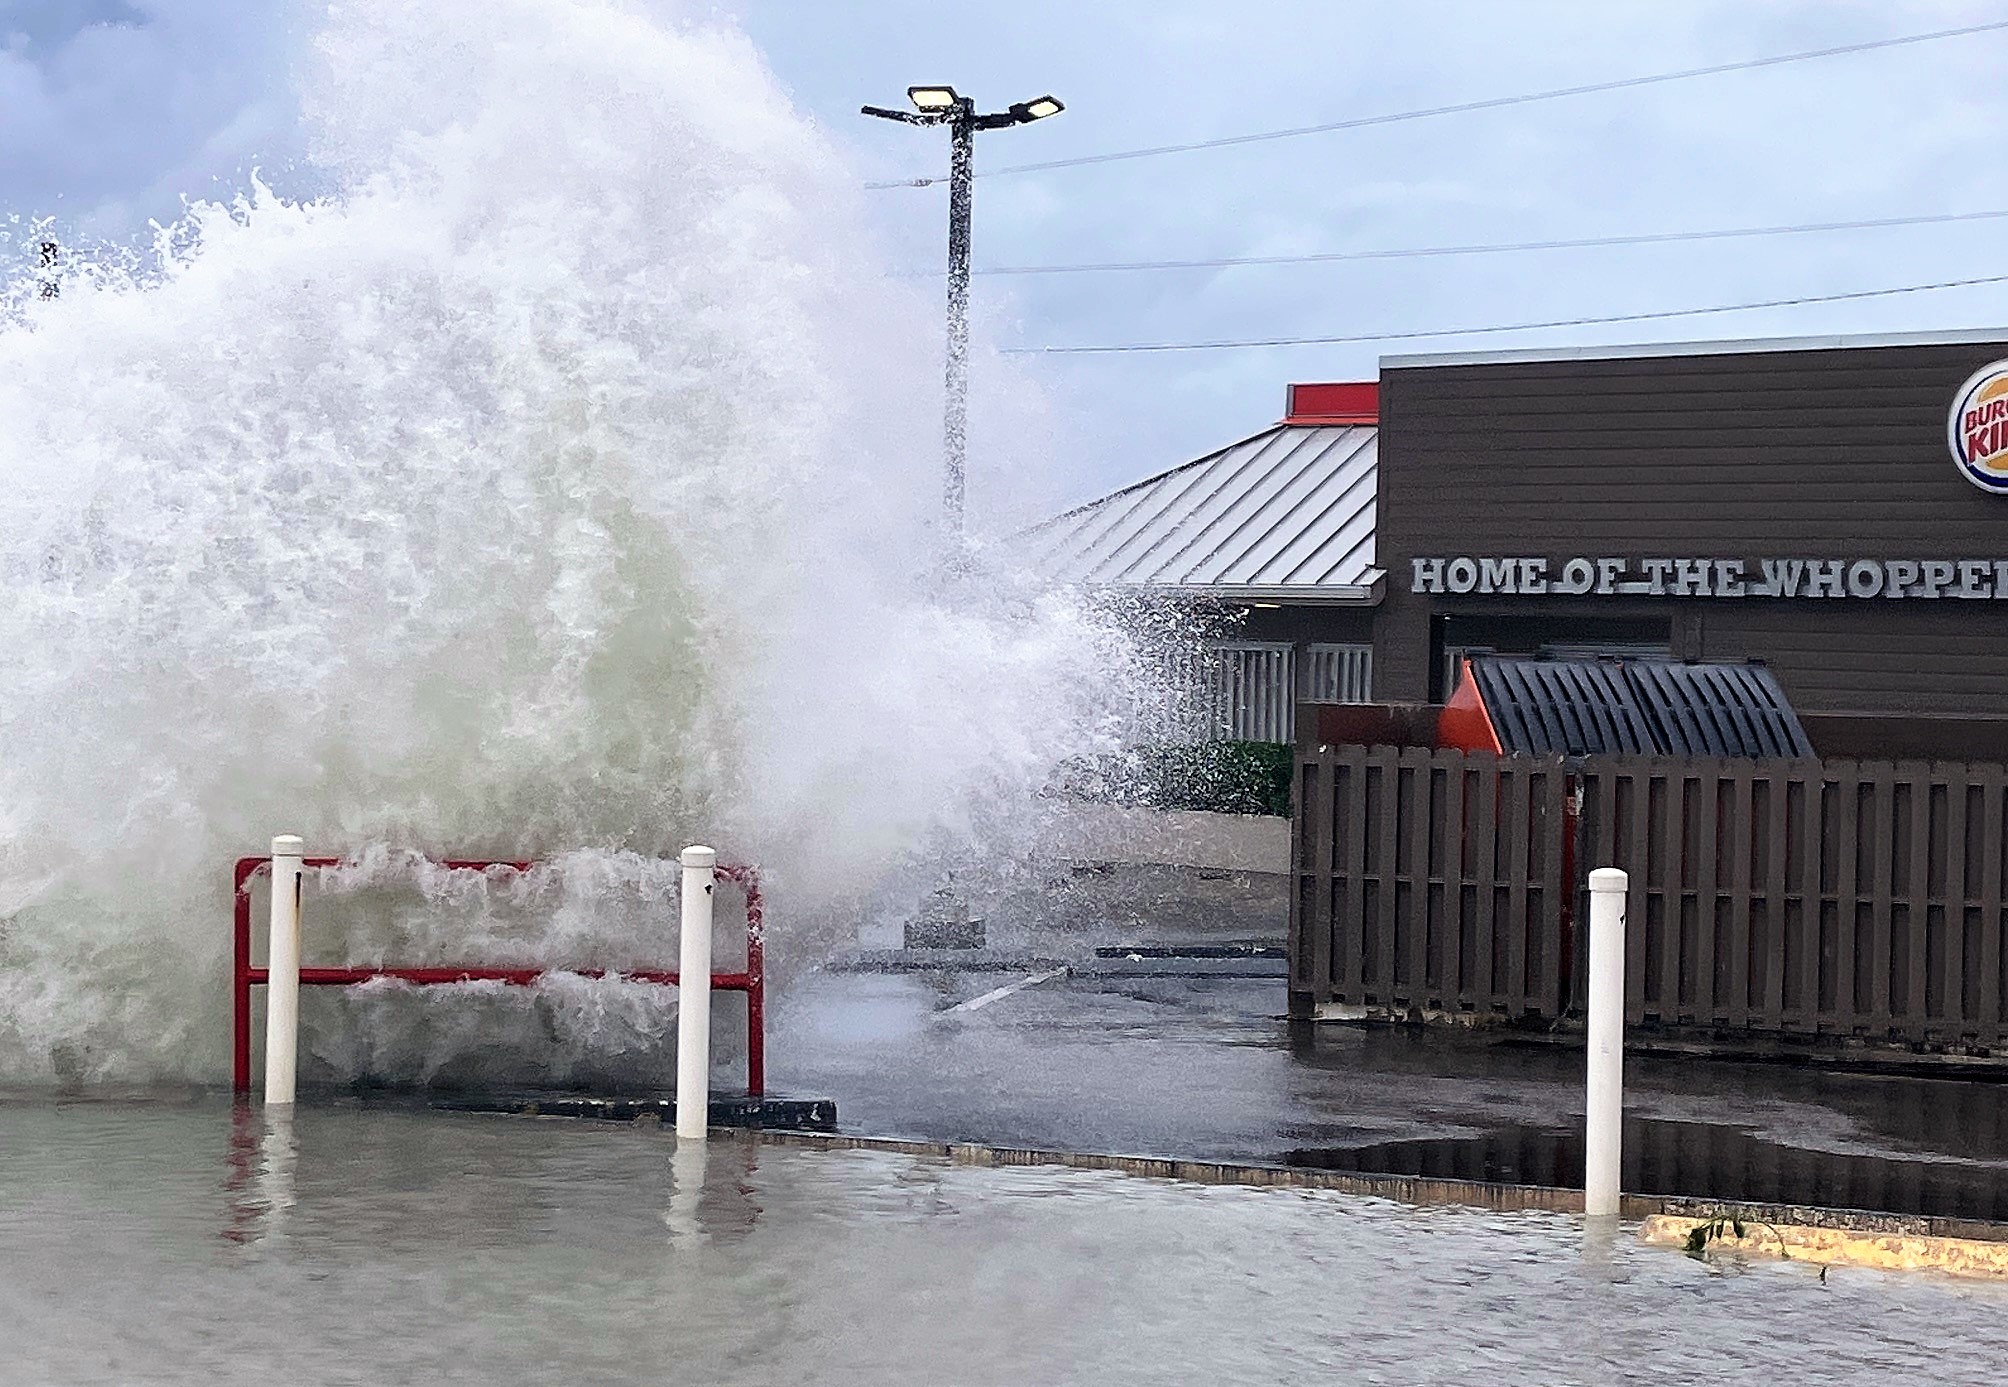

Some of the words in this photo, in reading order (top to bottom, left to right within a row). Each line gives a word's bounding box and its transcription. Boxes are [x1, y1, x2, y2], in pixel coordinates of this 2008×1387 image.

[1965, 399, 2008, 434] BUR
[1410, 557, 1548, 594] HOME
[1560, 557, 1627, 594] OF
[1641, 558, 1746, 597] THE
